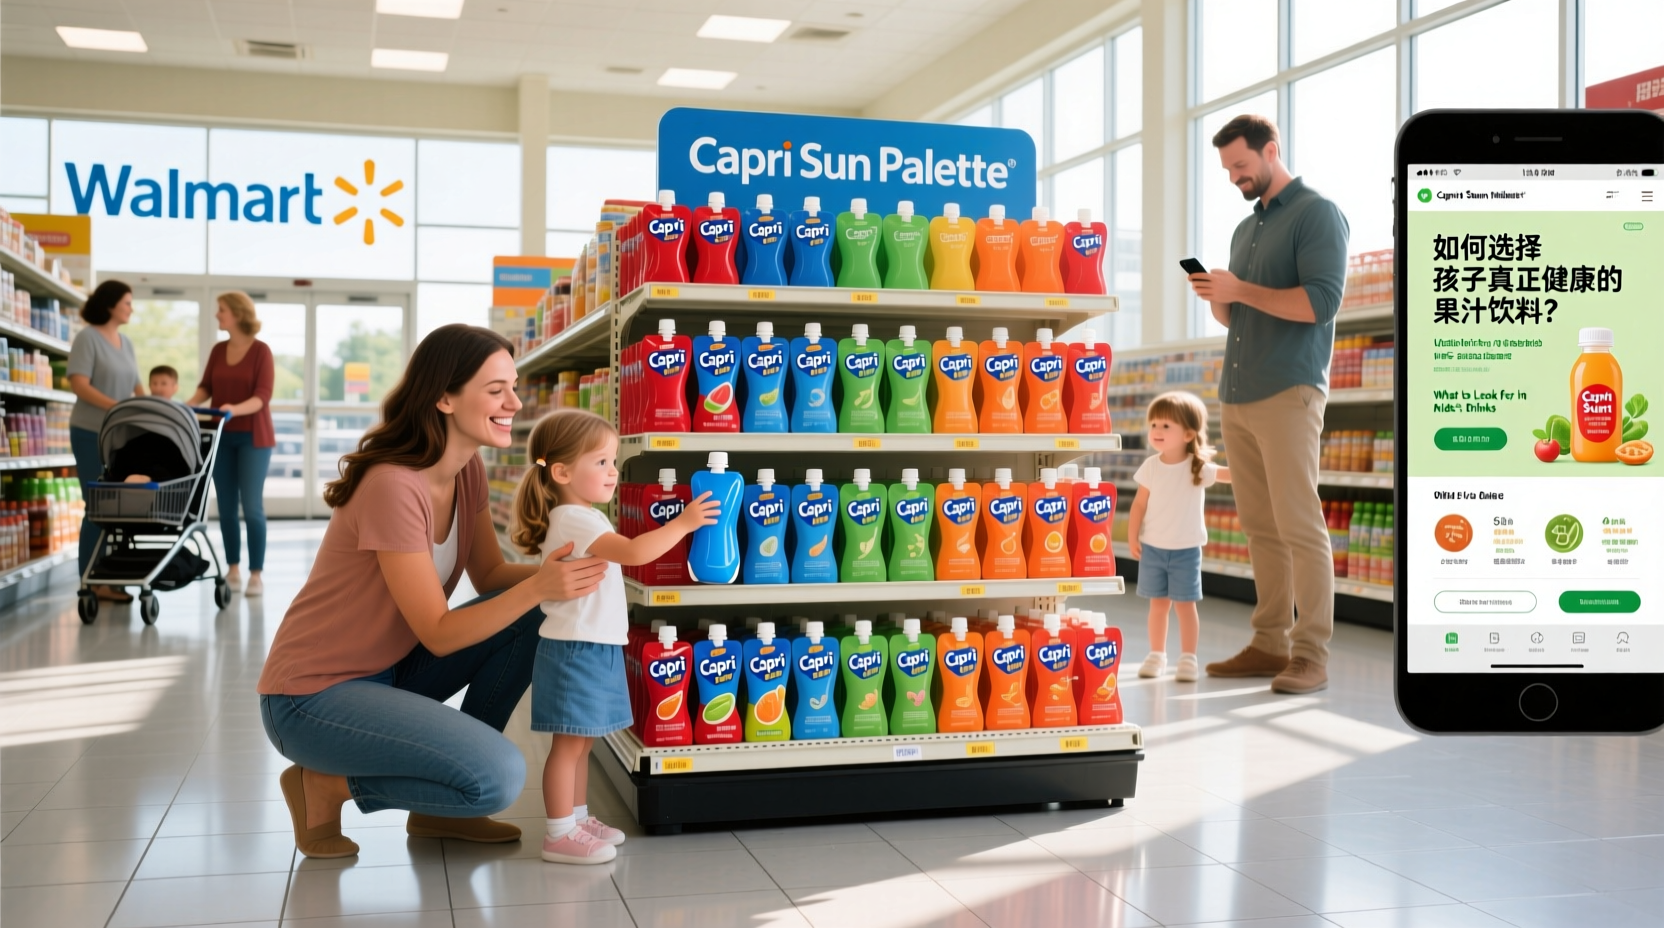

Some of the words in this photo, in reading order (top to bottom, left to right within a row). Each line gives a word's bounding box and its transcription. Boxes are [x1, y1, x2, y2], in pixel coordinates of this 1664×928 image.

[689, 136, 792, 184] Capri
[800, 142, 871, 181] Sun
[64, 162, 323, 225] Walmart
[649, 218, 684, 235] Capri
[700, 220, 734, 237] Capri
[749, 222, 782, 239] Capri
[1433, 233, 1542, 261] 如何选择
[1433, 265, 1623, 293] 孩子真正健康的
[649, 349, 686, 369] Capri
[699, 350, 735, 369] Capri
[748, 350, 783, 369] Capri
[797, 351, 831, 370] Capri
[845, 352, 878, 371] Capri
[750, 498, 784, 518] Capri
[798, 498, 832, 518] Capri
[848, 498, 880, 518] Capri
[650, 656, 686, 679] Capri
[700, 655, 736, 677] Capri
[750, 653, 786, 675] Capri
[799, 651, 833, 672] Capri
